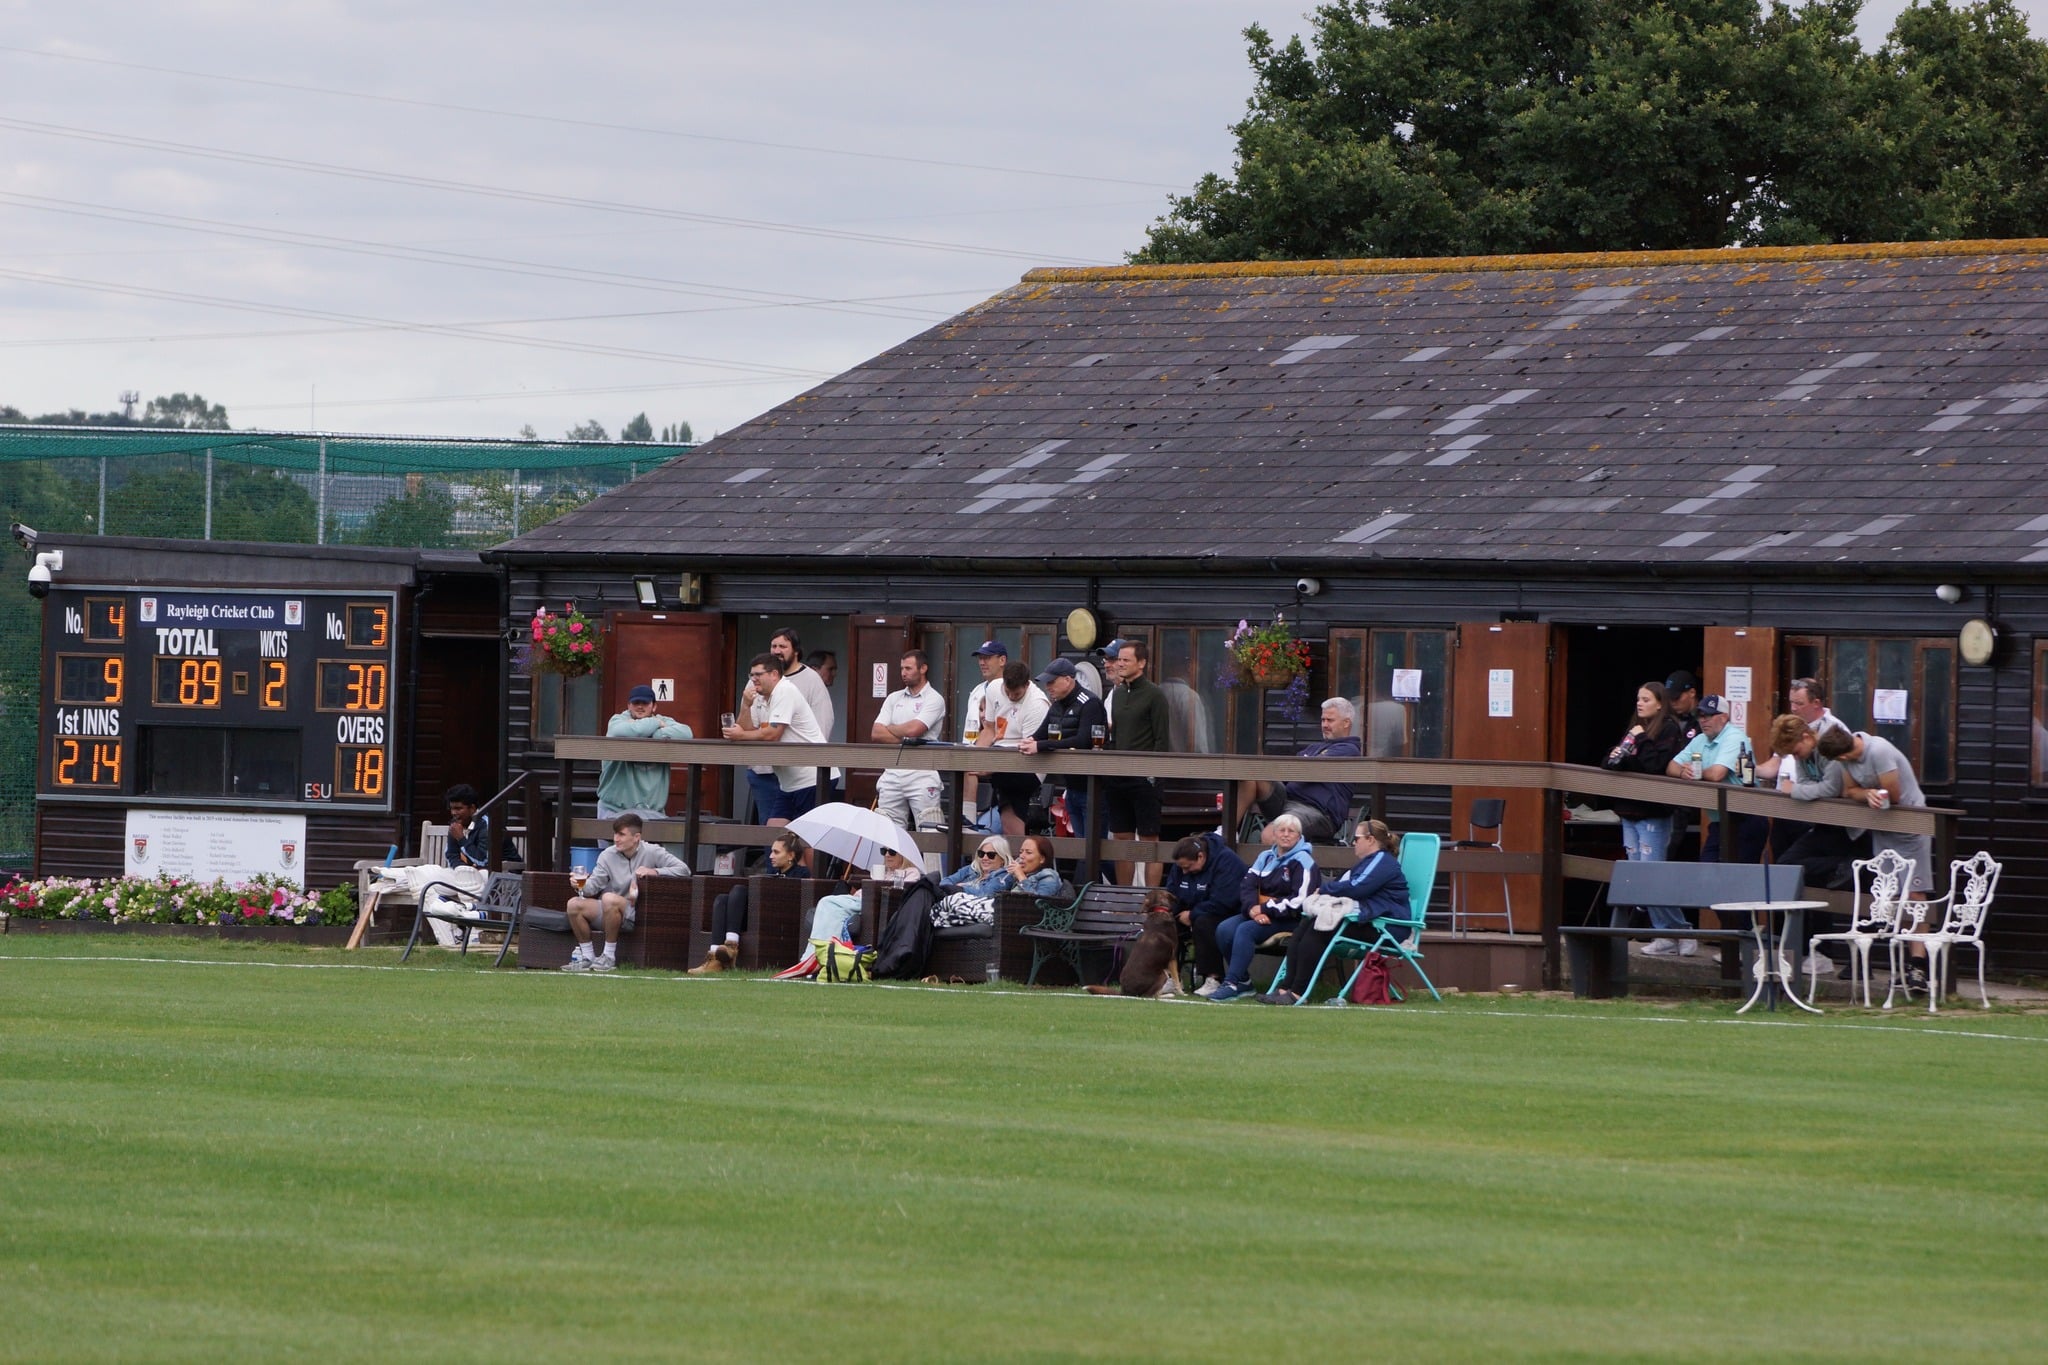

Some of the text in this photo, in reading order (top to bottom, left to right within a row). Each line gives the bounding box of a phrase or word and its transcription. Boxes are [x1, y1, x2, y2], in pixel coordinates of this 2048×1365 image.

[65, 607, 84, 635] No.
[108, 605, 125, 637] 4
[166, 603, 275, 621] Rayleigh Cricket Club
[326, 612, 346, 641] No.
[372, 608, 388, 646] 3
[156, 627, 219, 656] TOTAL
[260, 630, 288, 658] WKTS
[104, 658, 123, 703] 9
[179, 659, 221, 705] 89
[265, 662, 286, 707] 2
[345, 664, 386, 710] 30
[56, 707, 120, 736] 1st INNS
[337, 715, 385, 744] OVERS
[58, 740, 121, 784] 214
[354, 749, 384, 794] 18
[304, 783, 332, 798] ESU
